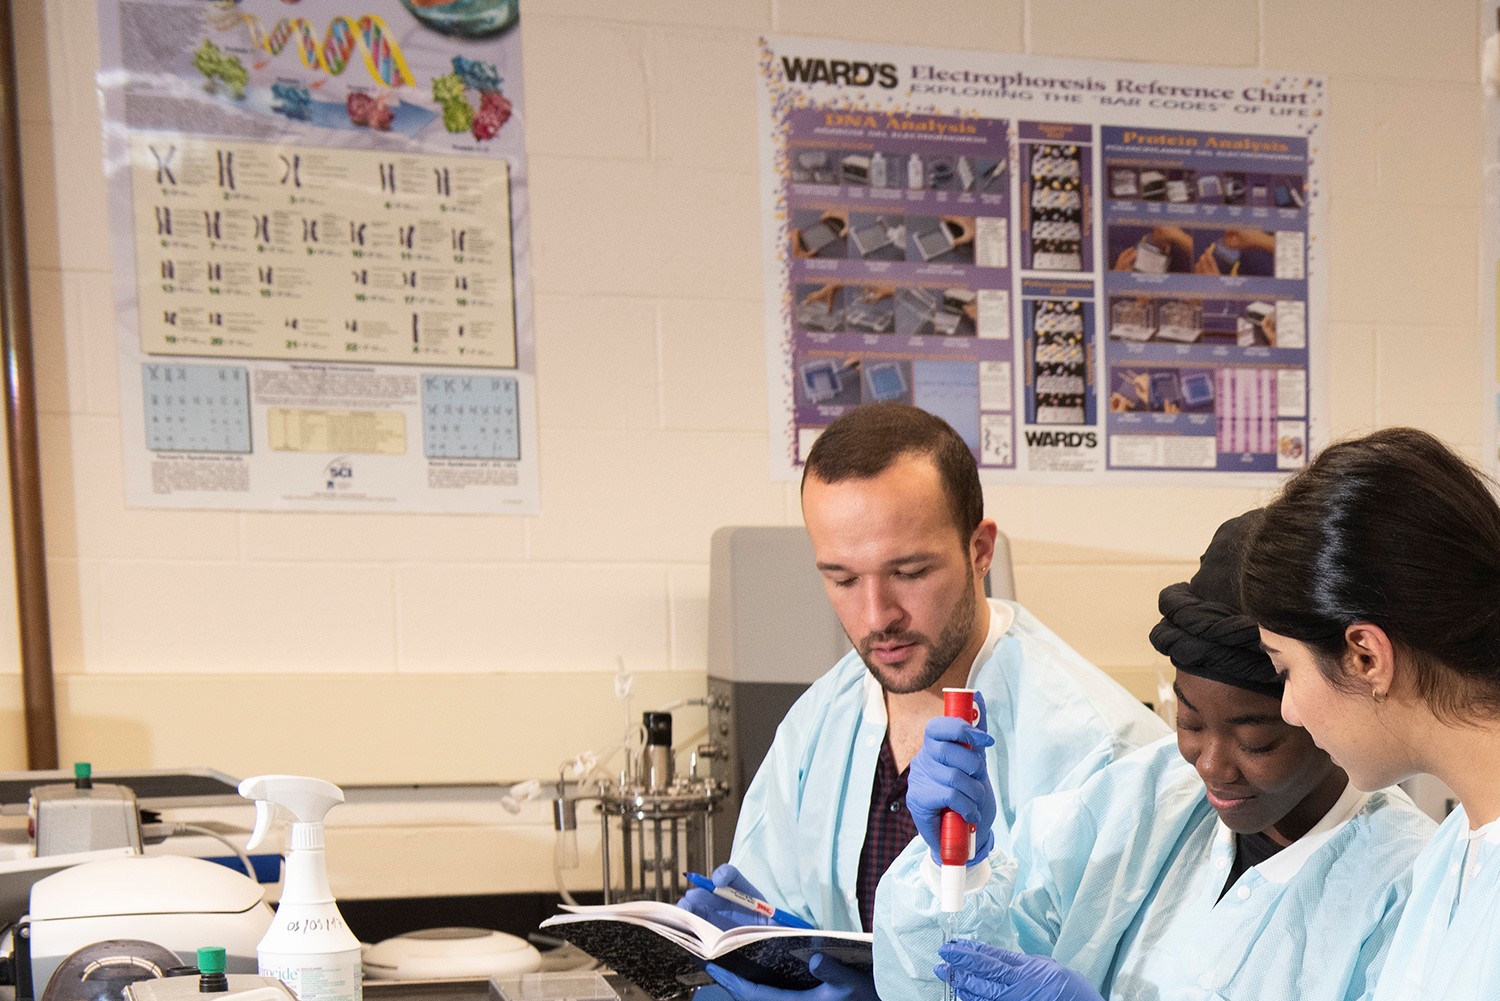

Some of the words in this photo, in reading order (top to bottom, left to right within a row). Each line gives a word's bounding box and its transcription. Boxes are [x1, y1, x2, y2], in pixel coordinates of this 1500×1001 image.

[782, 56, 898, 89] WARD'S
[911, 65, 1106, 91] Electrophoresis
[1116, 78, 1235, 100] Reference
[1243, 87, 1308, 105] Chart
[910, 84, 1033, 100] EXPLORING
[1043, 92, 1083, 104] THE
[1233, 103, 1261, 114] OF
[1269, 106, 1309, 118] LIFE
[824, 113, 877, 128] DNA
[886, 115, 977, 135] Analysis
[1122, 131, 1199, 147] Protein
[1204, 136, 1289, 153] Analysis
[1024, 431, 1098, 448] WARD'S
